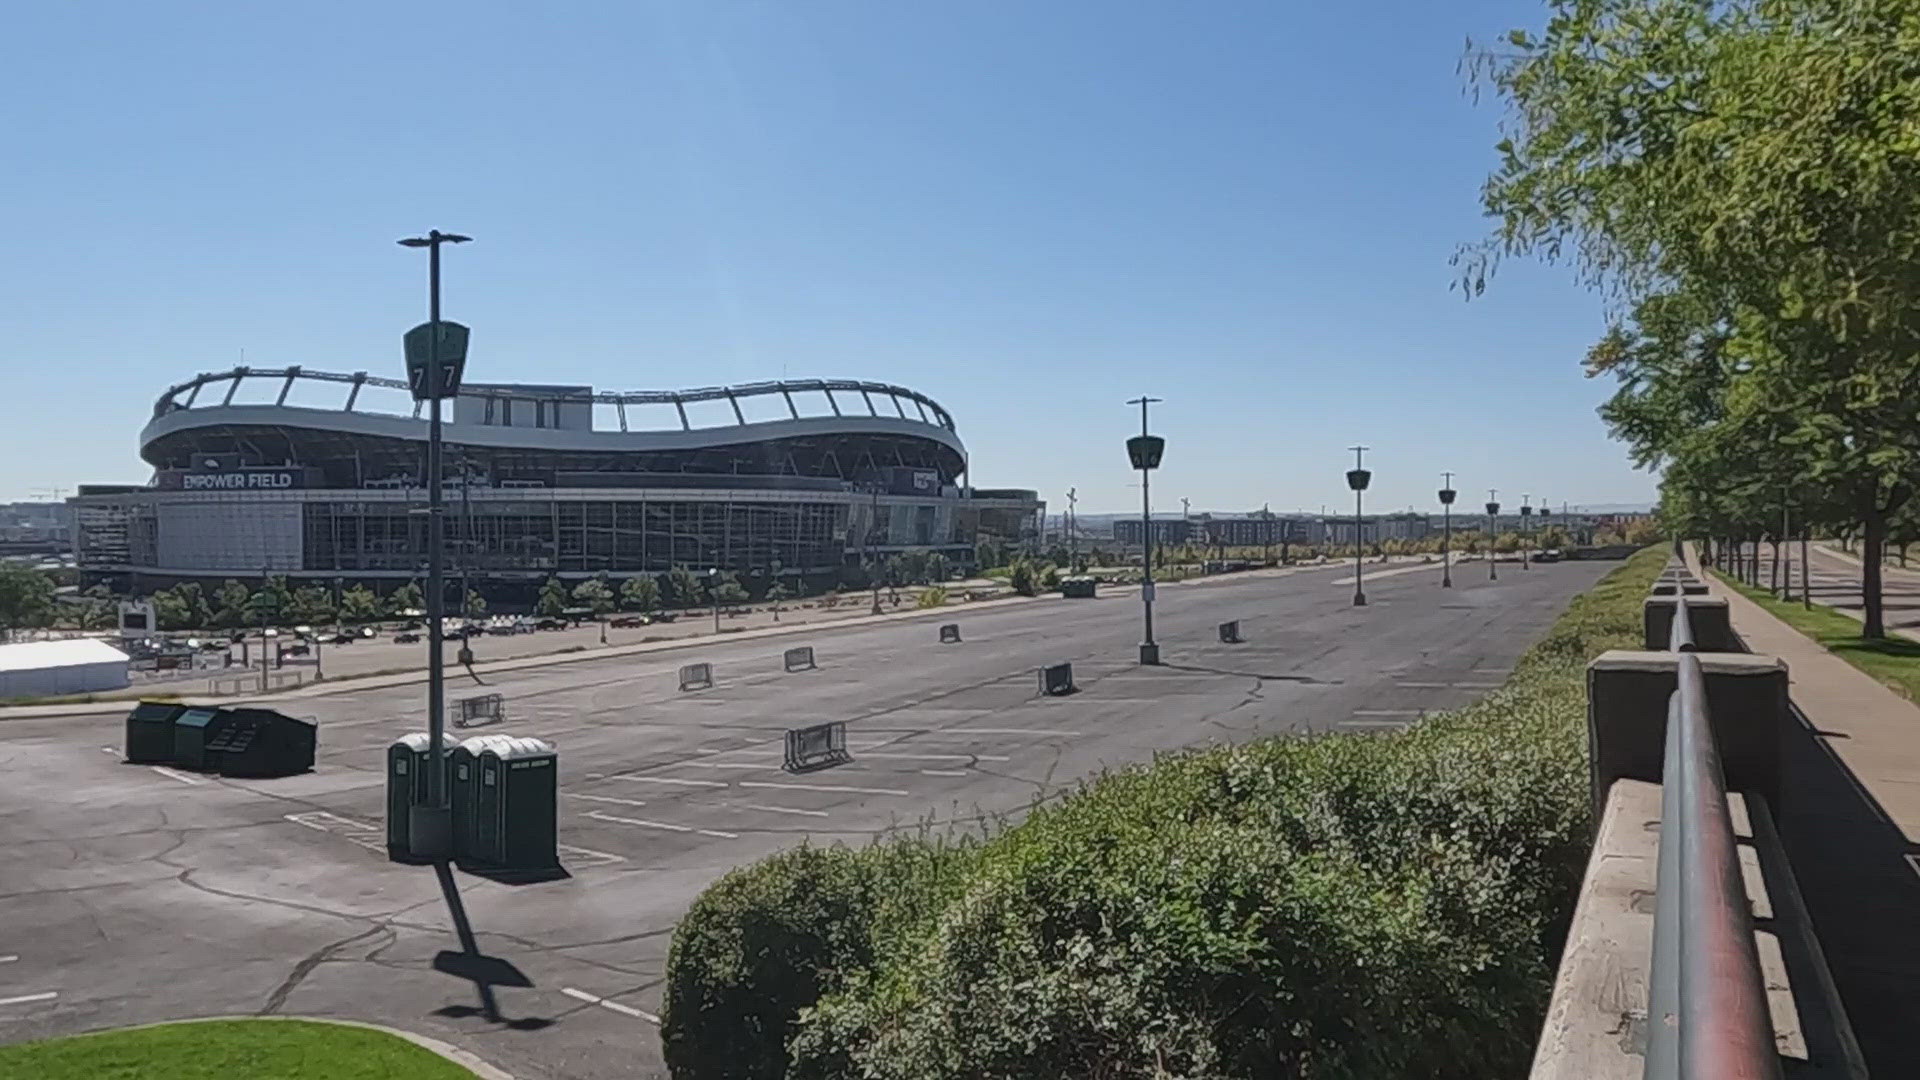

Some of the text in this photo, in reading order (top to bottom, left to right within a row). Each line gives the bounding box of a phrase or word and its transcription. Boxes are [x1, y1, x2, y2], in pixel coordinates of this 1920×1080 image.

[413, 367, 424, 389] 7
[443, 365, 455, 388] 7
[248, 473, 292, 488] FIELD
